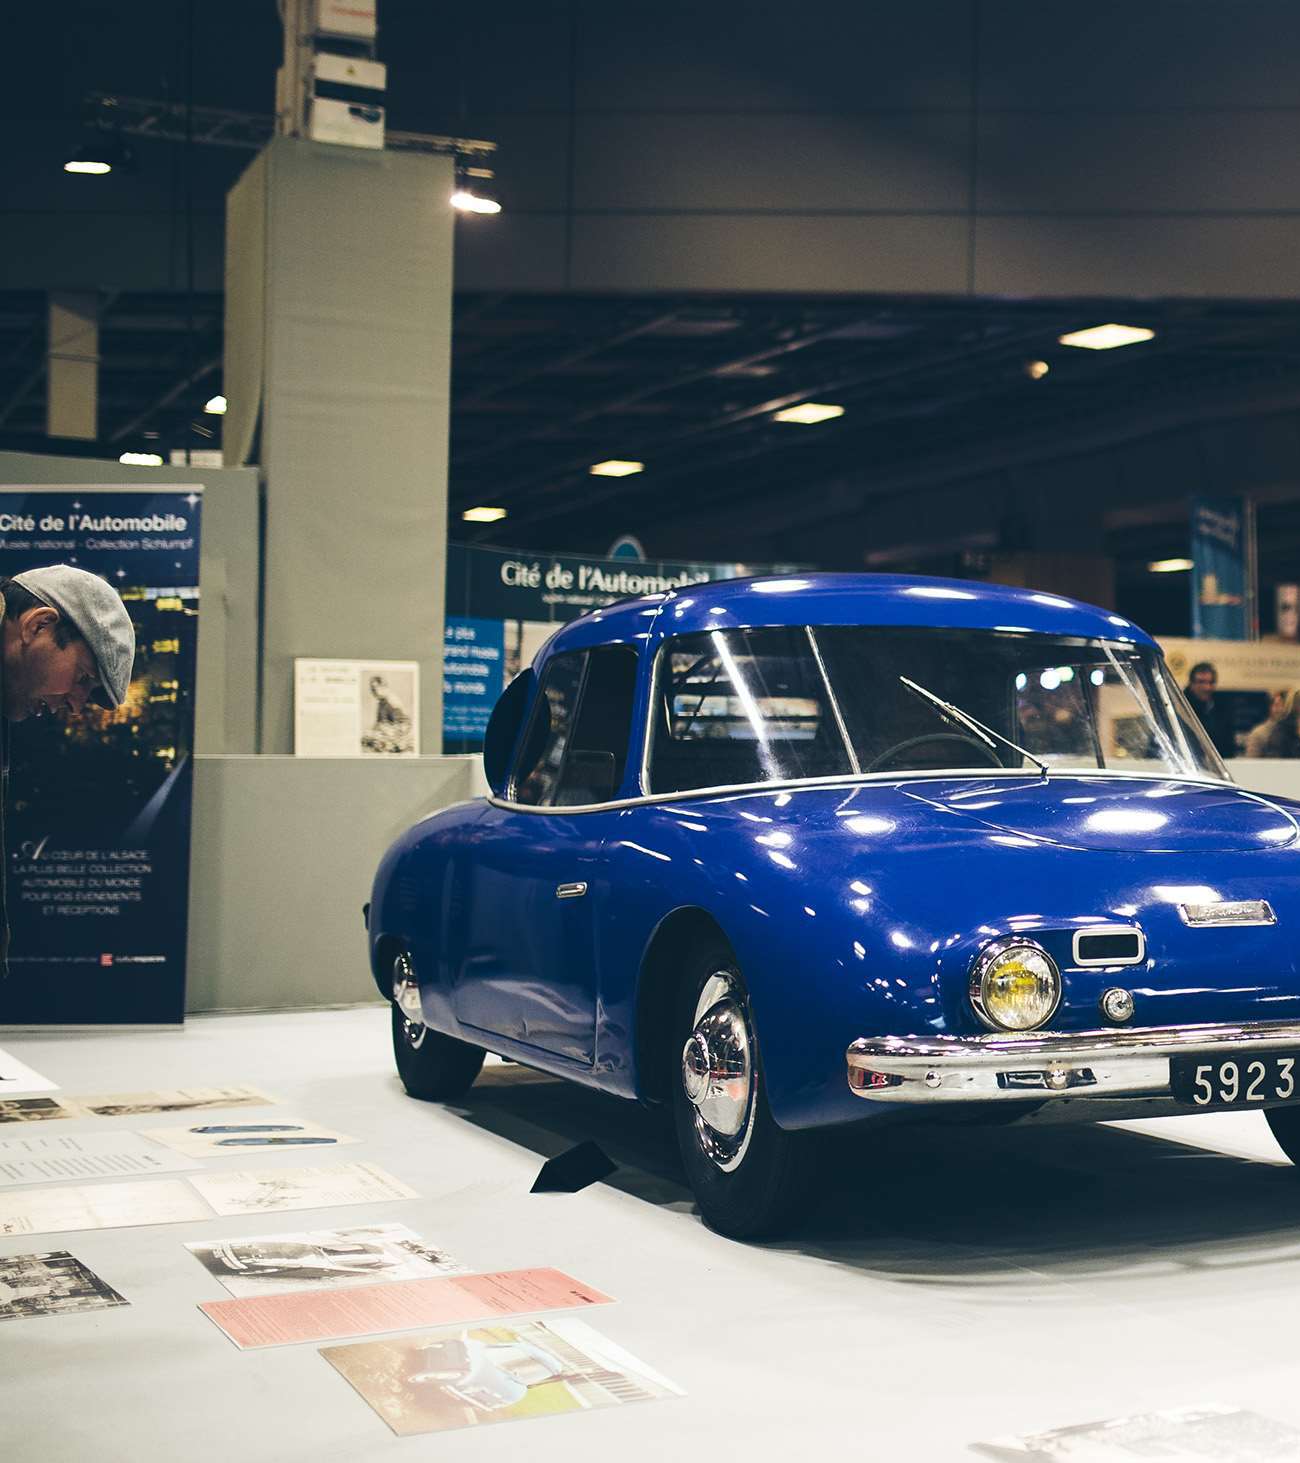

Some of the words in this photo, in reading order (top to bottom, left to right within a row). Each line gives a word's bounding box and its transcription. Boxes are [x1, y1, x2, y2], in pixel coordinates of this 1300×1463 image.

[0, 513, 35, 531] Cité
[40, 515, 64, 531] de
[69, 513, 187, 531] l'Automobile
[500, 560, 541, 589] Cité
[545, 563, 574, 590] de
[88, 863, 152, 874] COLLECTION
[22, 878, 84, 888] AUTOMOBILE
[104, 878, 142, 888] MONDE
[1193, 1058, 1295, 1105] 5923
